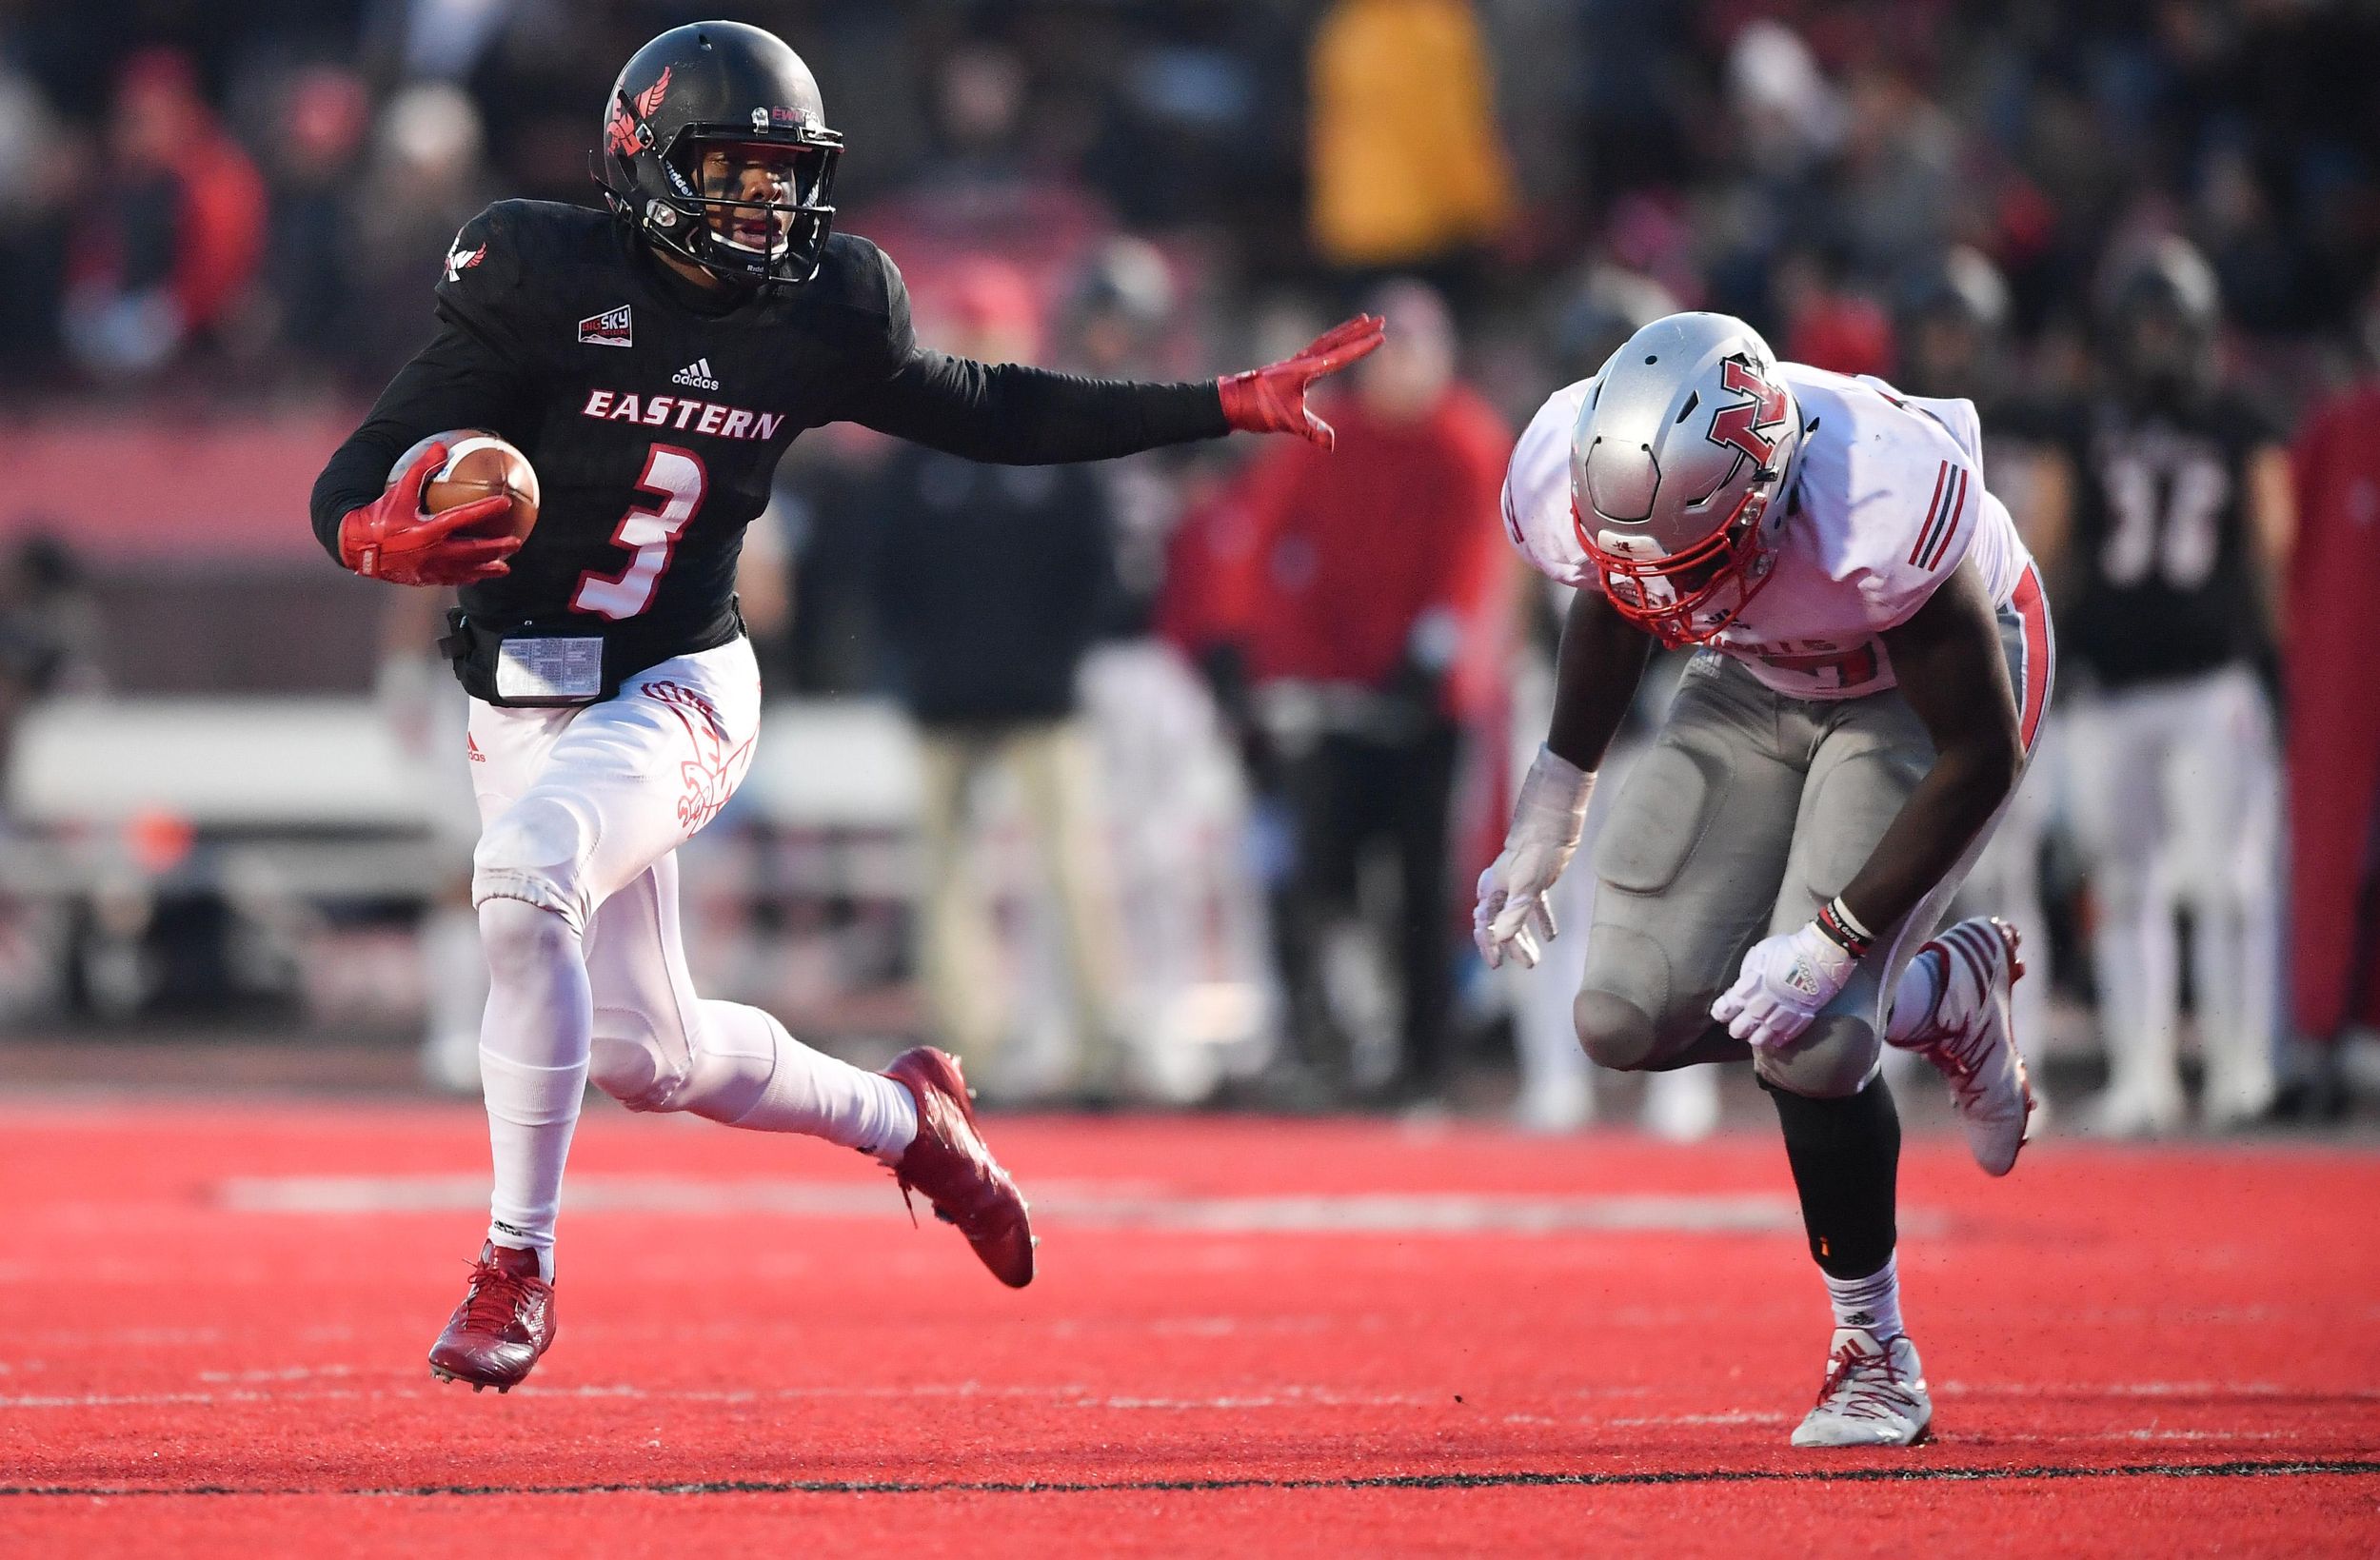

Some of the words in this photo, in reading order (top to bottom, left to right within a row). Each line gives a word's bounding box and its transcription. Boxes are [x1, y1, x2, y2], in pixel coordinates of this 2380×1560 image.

[581, 388, 785, 441] EASTERN
[672, 373, 720, 391] adidas
[1706, 352, 1786, 469] N
[568, 443, 709, 623] 3
